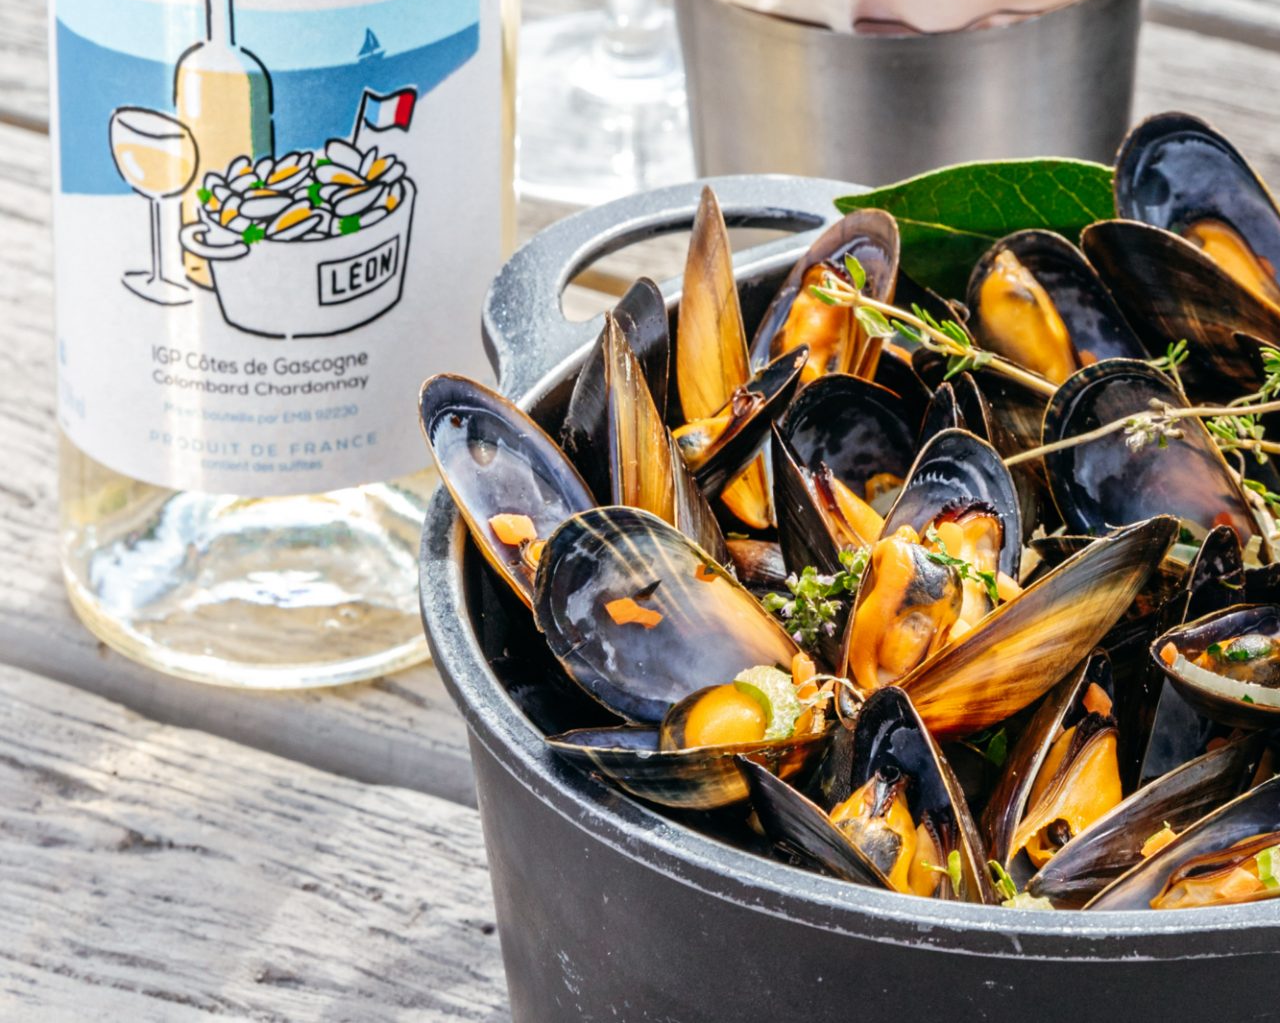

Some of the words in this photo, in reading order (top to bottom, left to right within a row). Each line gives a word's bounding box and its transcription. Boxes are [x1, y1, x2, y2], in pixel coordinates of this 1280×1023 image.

[331, 249, 394, 295] LÉON
[152, 345, 181, 365] IGP
[186, 352, 238, 375] Côtes
[244, 358, 267, 375] de
[274, 350, 369, 378] Gascogne
[152, 370, 249, 396] Colombard
[254, 375, 370, 396] Chardonnay
[149, 429, 241, 455] PRODUIT
[251, 444, 278, 458] DE
[290, 432, 378, 455] FRANCE
